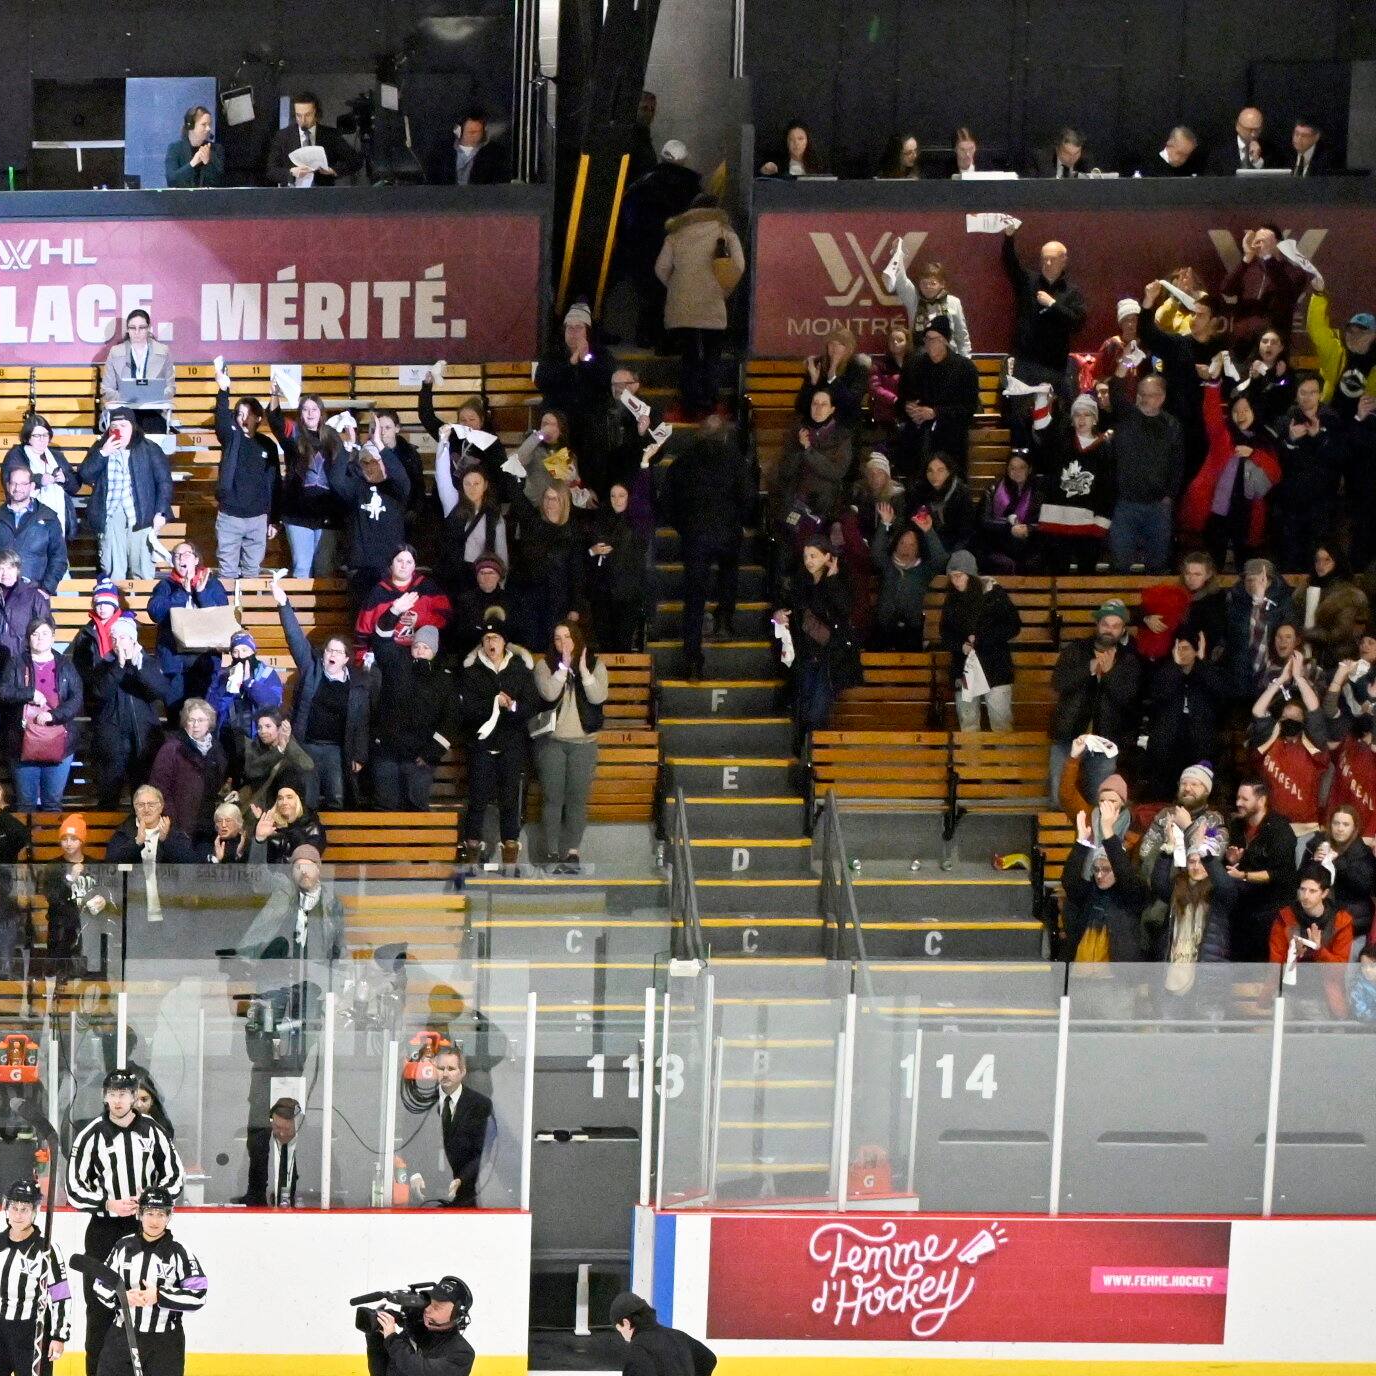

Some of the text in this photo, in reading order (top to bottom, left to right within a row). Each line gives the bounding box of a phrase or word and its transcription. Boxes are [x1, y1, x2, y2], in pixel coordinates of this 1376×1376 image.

[200, 263, 468, 341] MÉRITÉ.
[711, 687, 728, 712] F
[722, 765, 739, 791] E
[732, 847, 749, 872] D
[565, 929, 583, 954] C
[742, 928, 760, 954] C
[924, 930, 943, 956] C
[899, 1053, 998, 1099] 114
[1102, 1275, 1214, 1289] WWW.FEMME.HOCKEY
